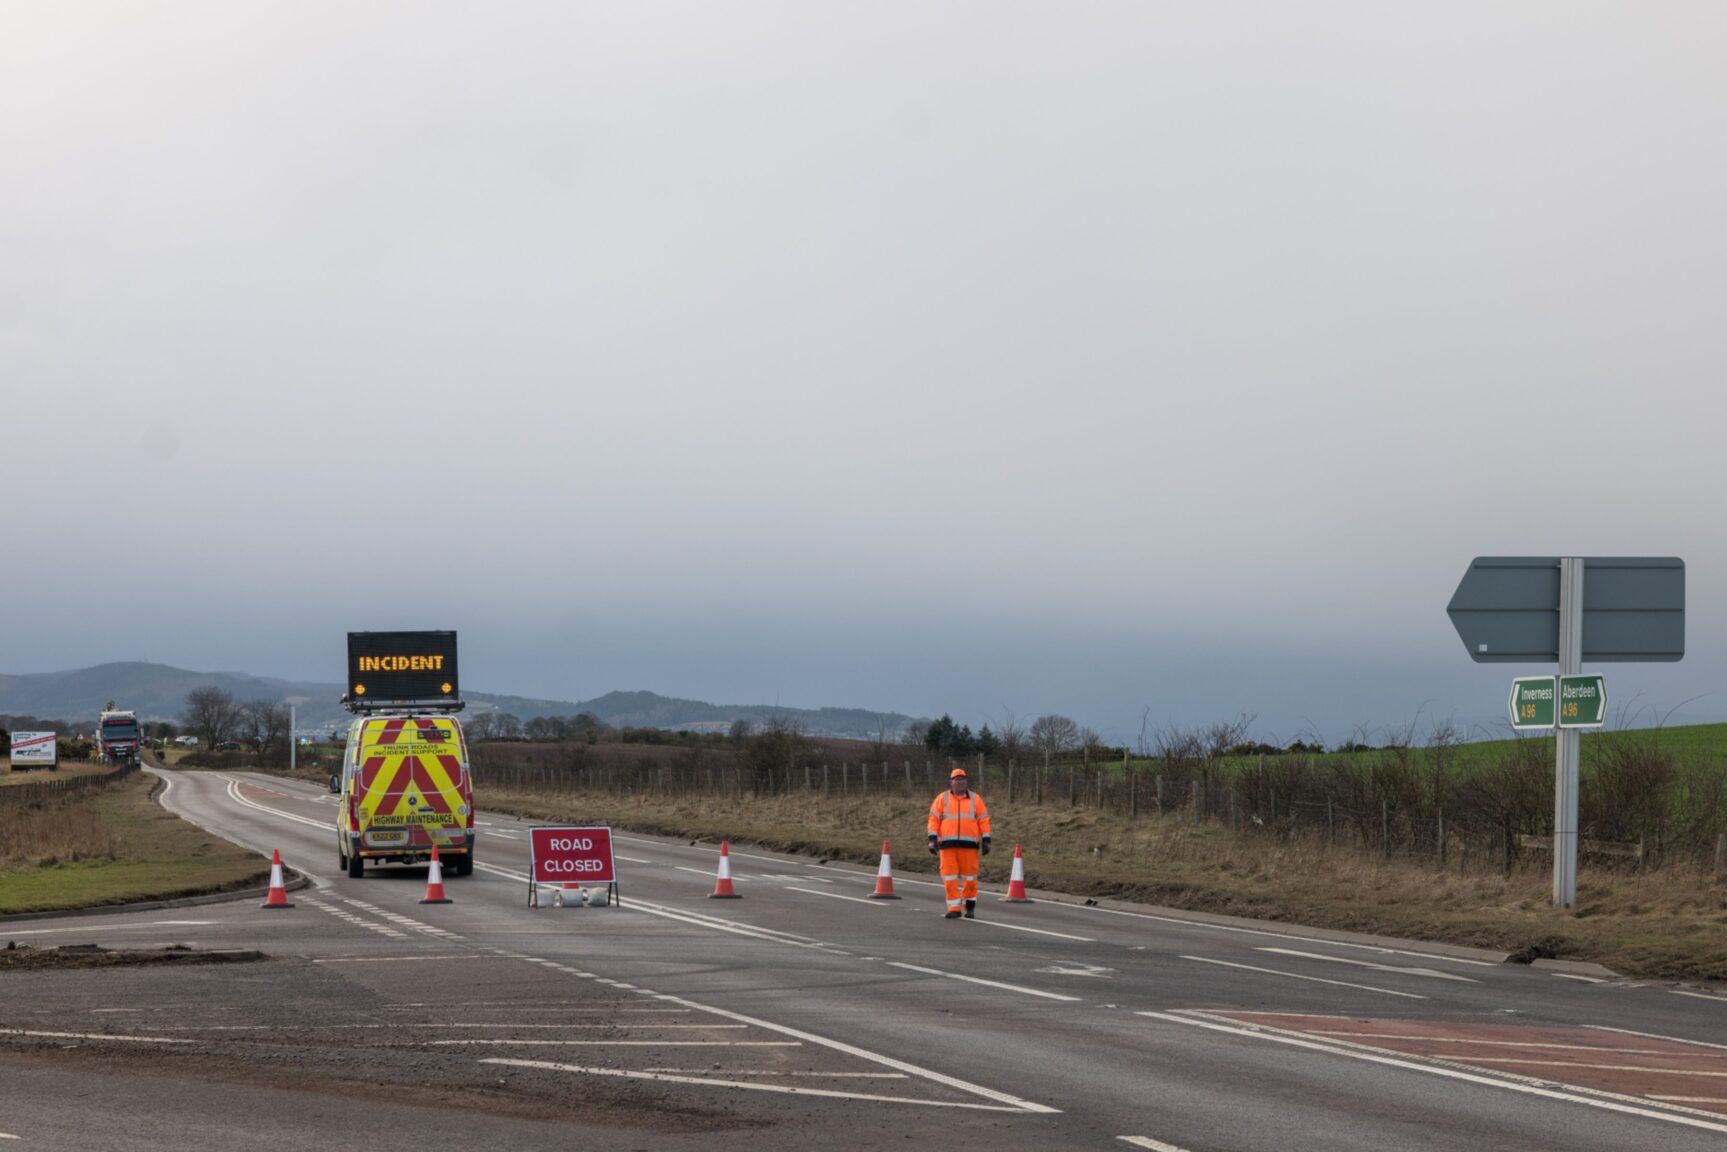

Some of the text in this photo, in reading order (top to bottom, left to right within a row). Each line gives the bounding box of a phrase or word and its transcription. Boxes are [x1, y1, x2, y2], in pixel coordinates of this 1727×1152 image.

[359, 655, 444, 671] INCIDENT
[1521, 687, 1552, 700] Inverness
[1562, 684, 1596, 698] Aberdeen
[1521, 704, 1536, 718] A96
[1562, 702, 1578, 717] A96
[374, 814, 452, 825] HIGHWAY MAINTENANCE
[550, 838, 593, 850] ROAD
[544, 859, 603, 872] CLOSED
